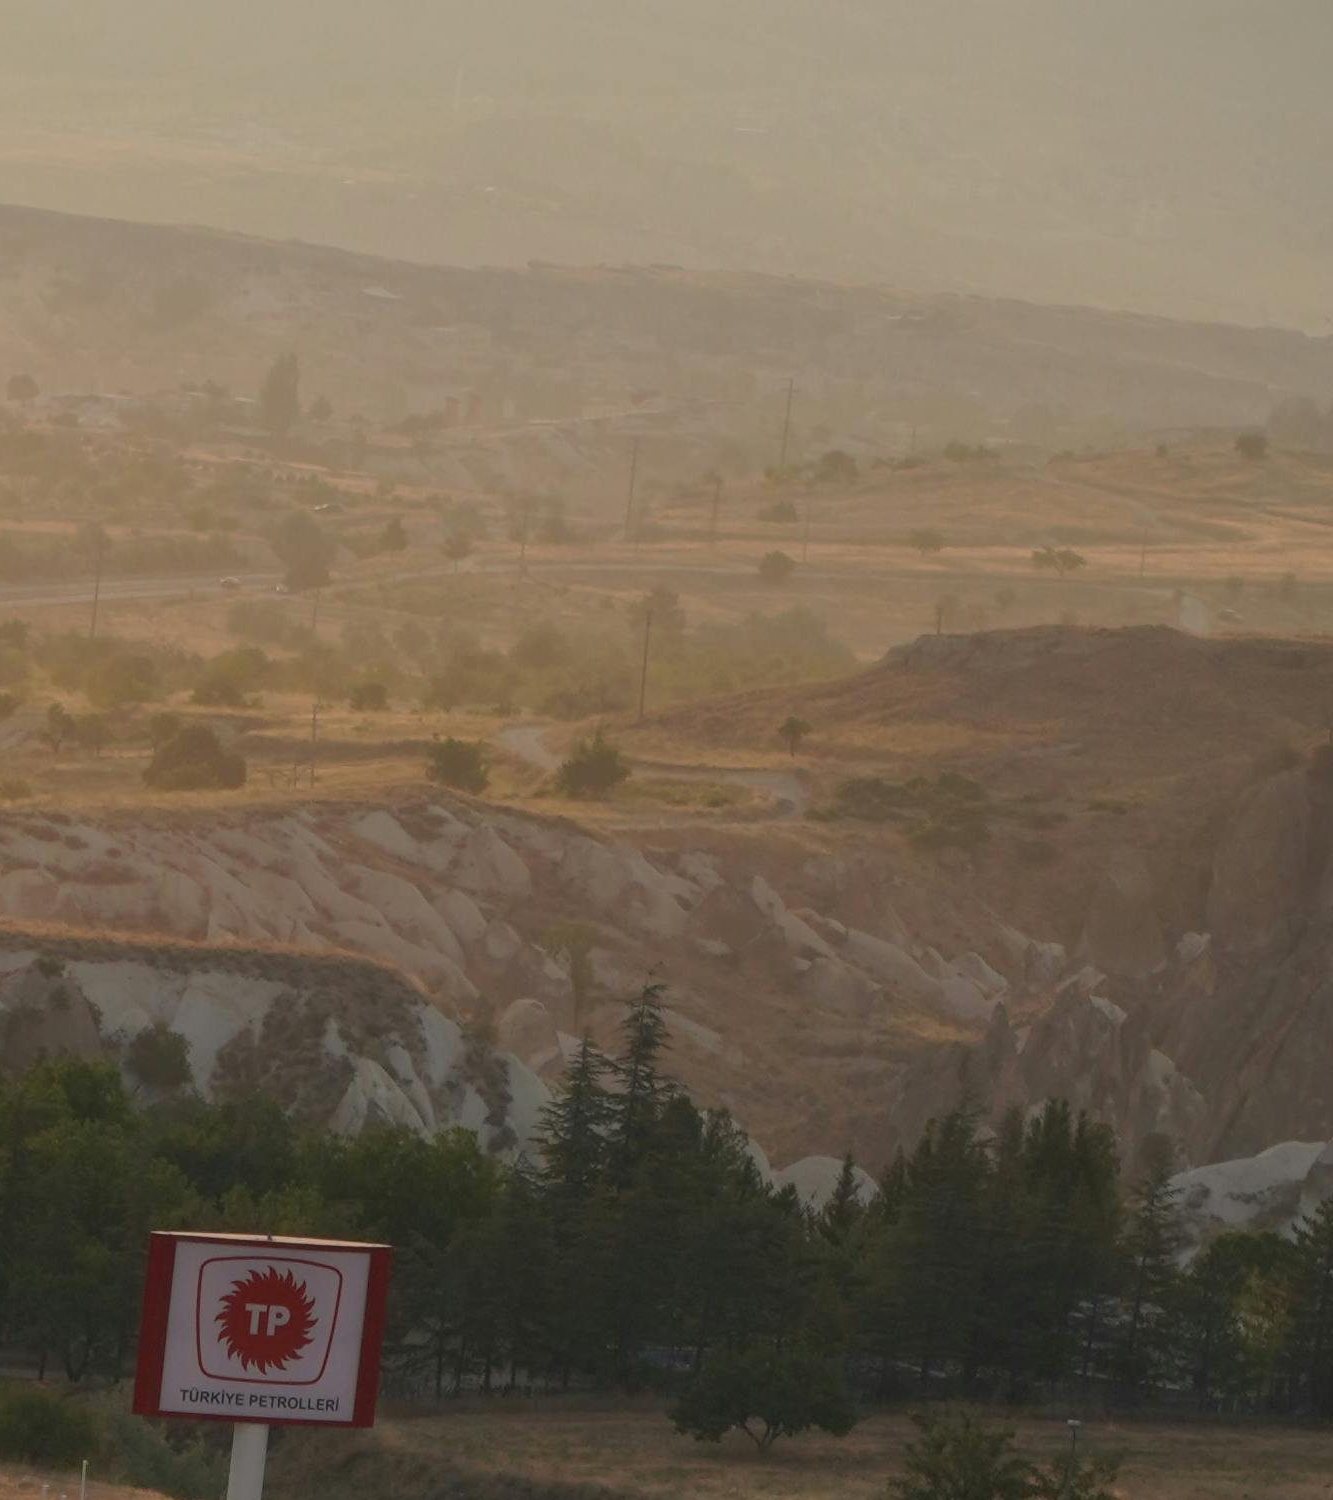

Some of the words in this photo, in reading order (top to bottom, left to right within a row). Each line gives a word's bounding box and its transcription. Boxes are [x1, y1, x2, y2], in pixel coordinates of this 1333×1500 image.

[245, 1303, 291, 1337] TP
[180, 1387, 245, 1407] TÜRKİYE
[249, 1394, 340, 1412] PETROLLERİ
